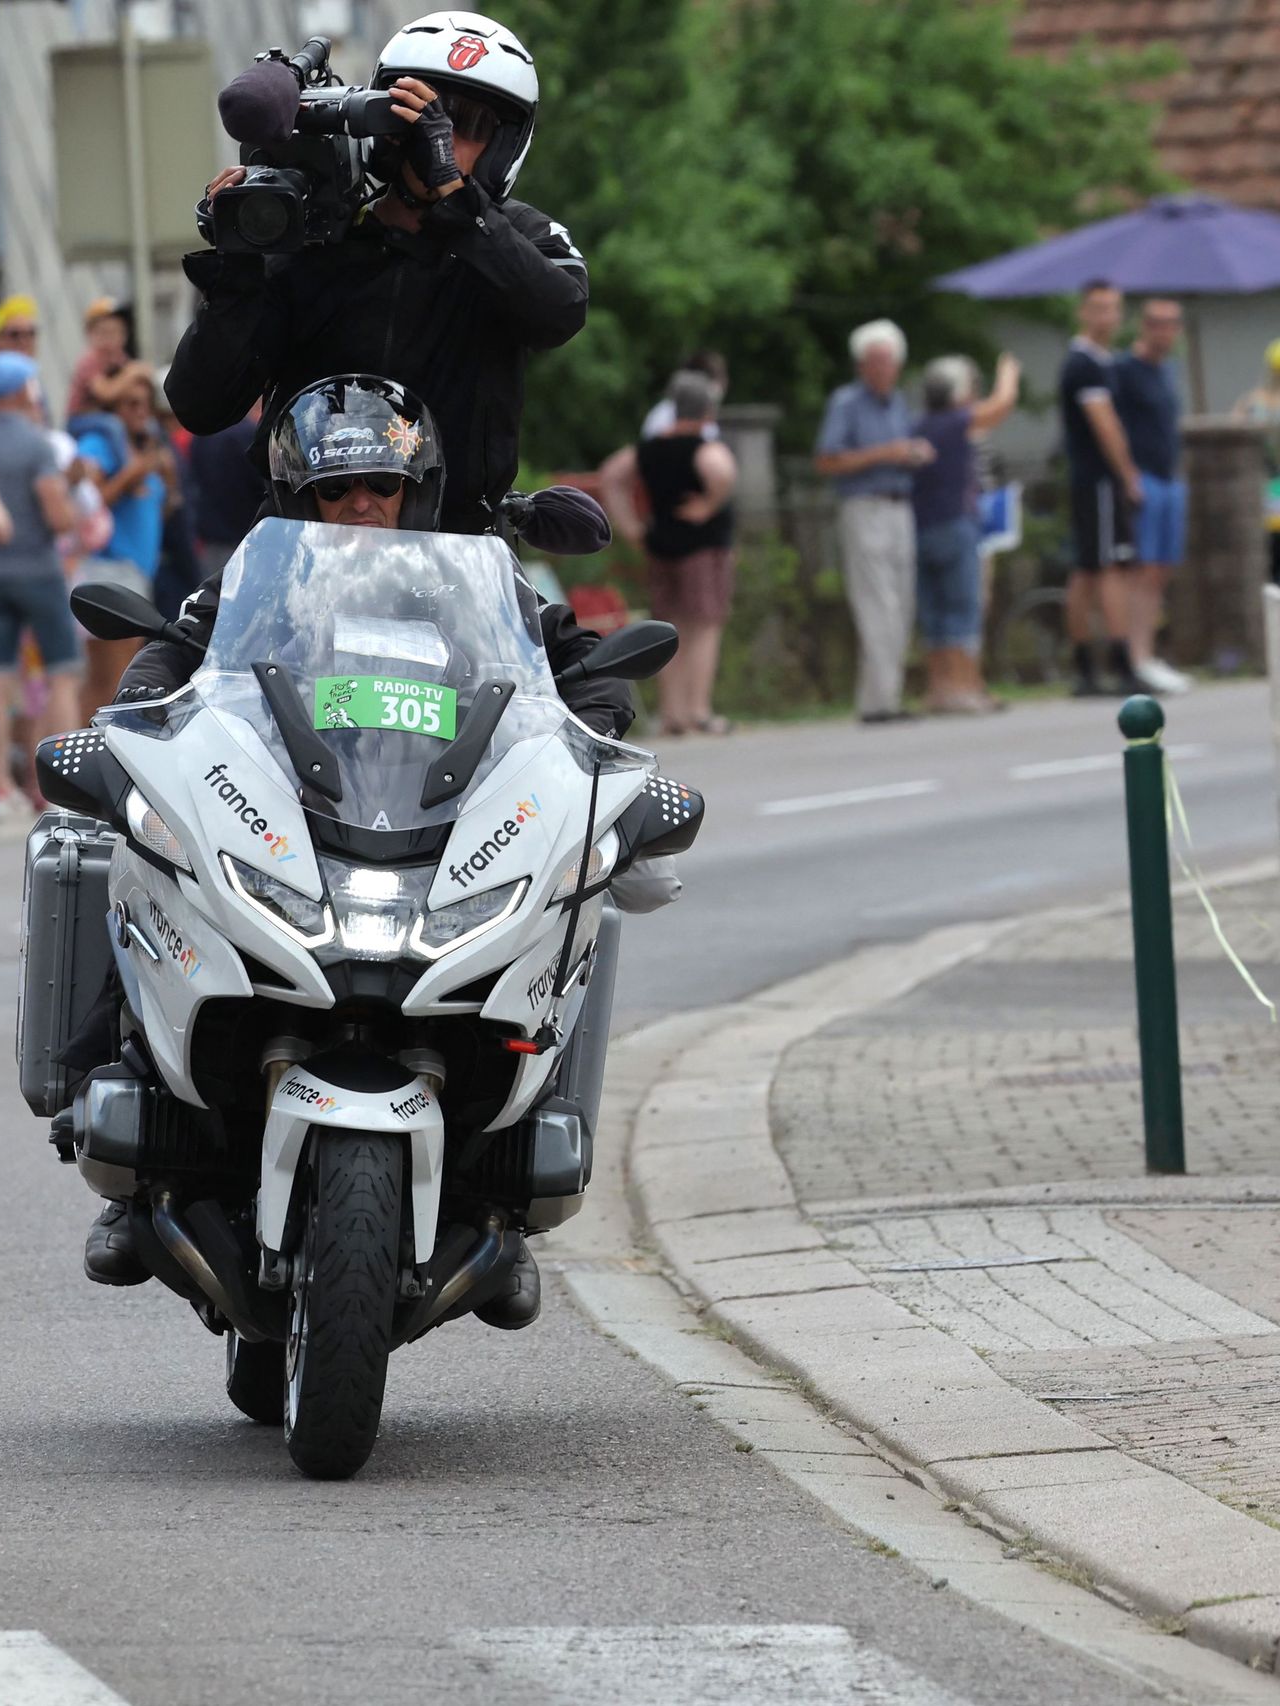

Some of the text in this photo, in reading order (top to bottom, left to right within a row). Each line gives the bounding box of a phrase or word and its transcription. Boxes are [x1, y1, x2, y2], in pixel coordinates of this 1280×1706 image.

[321, 445, 388, 459] SCOTT
[373, 680, 443, 702] RADIO-TV
[380, 695, 441, 733] 305
